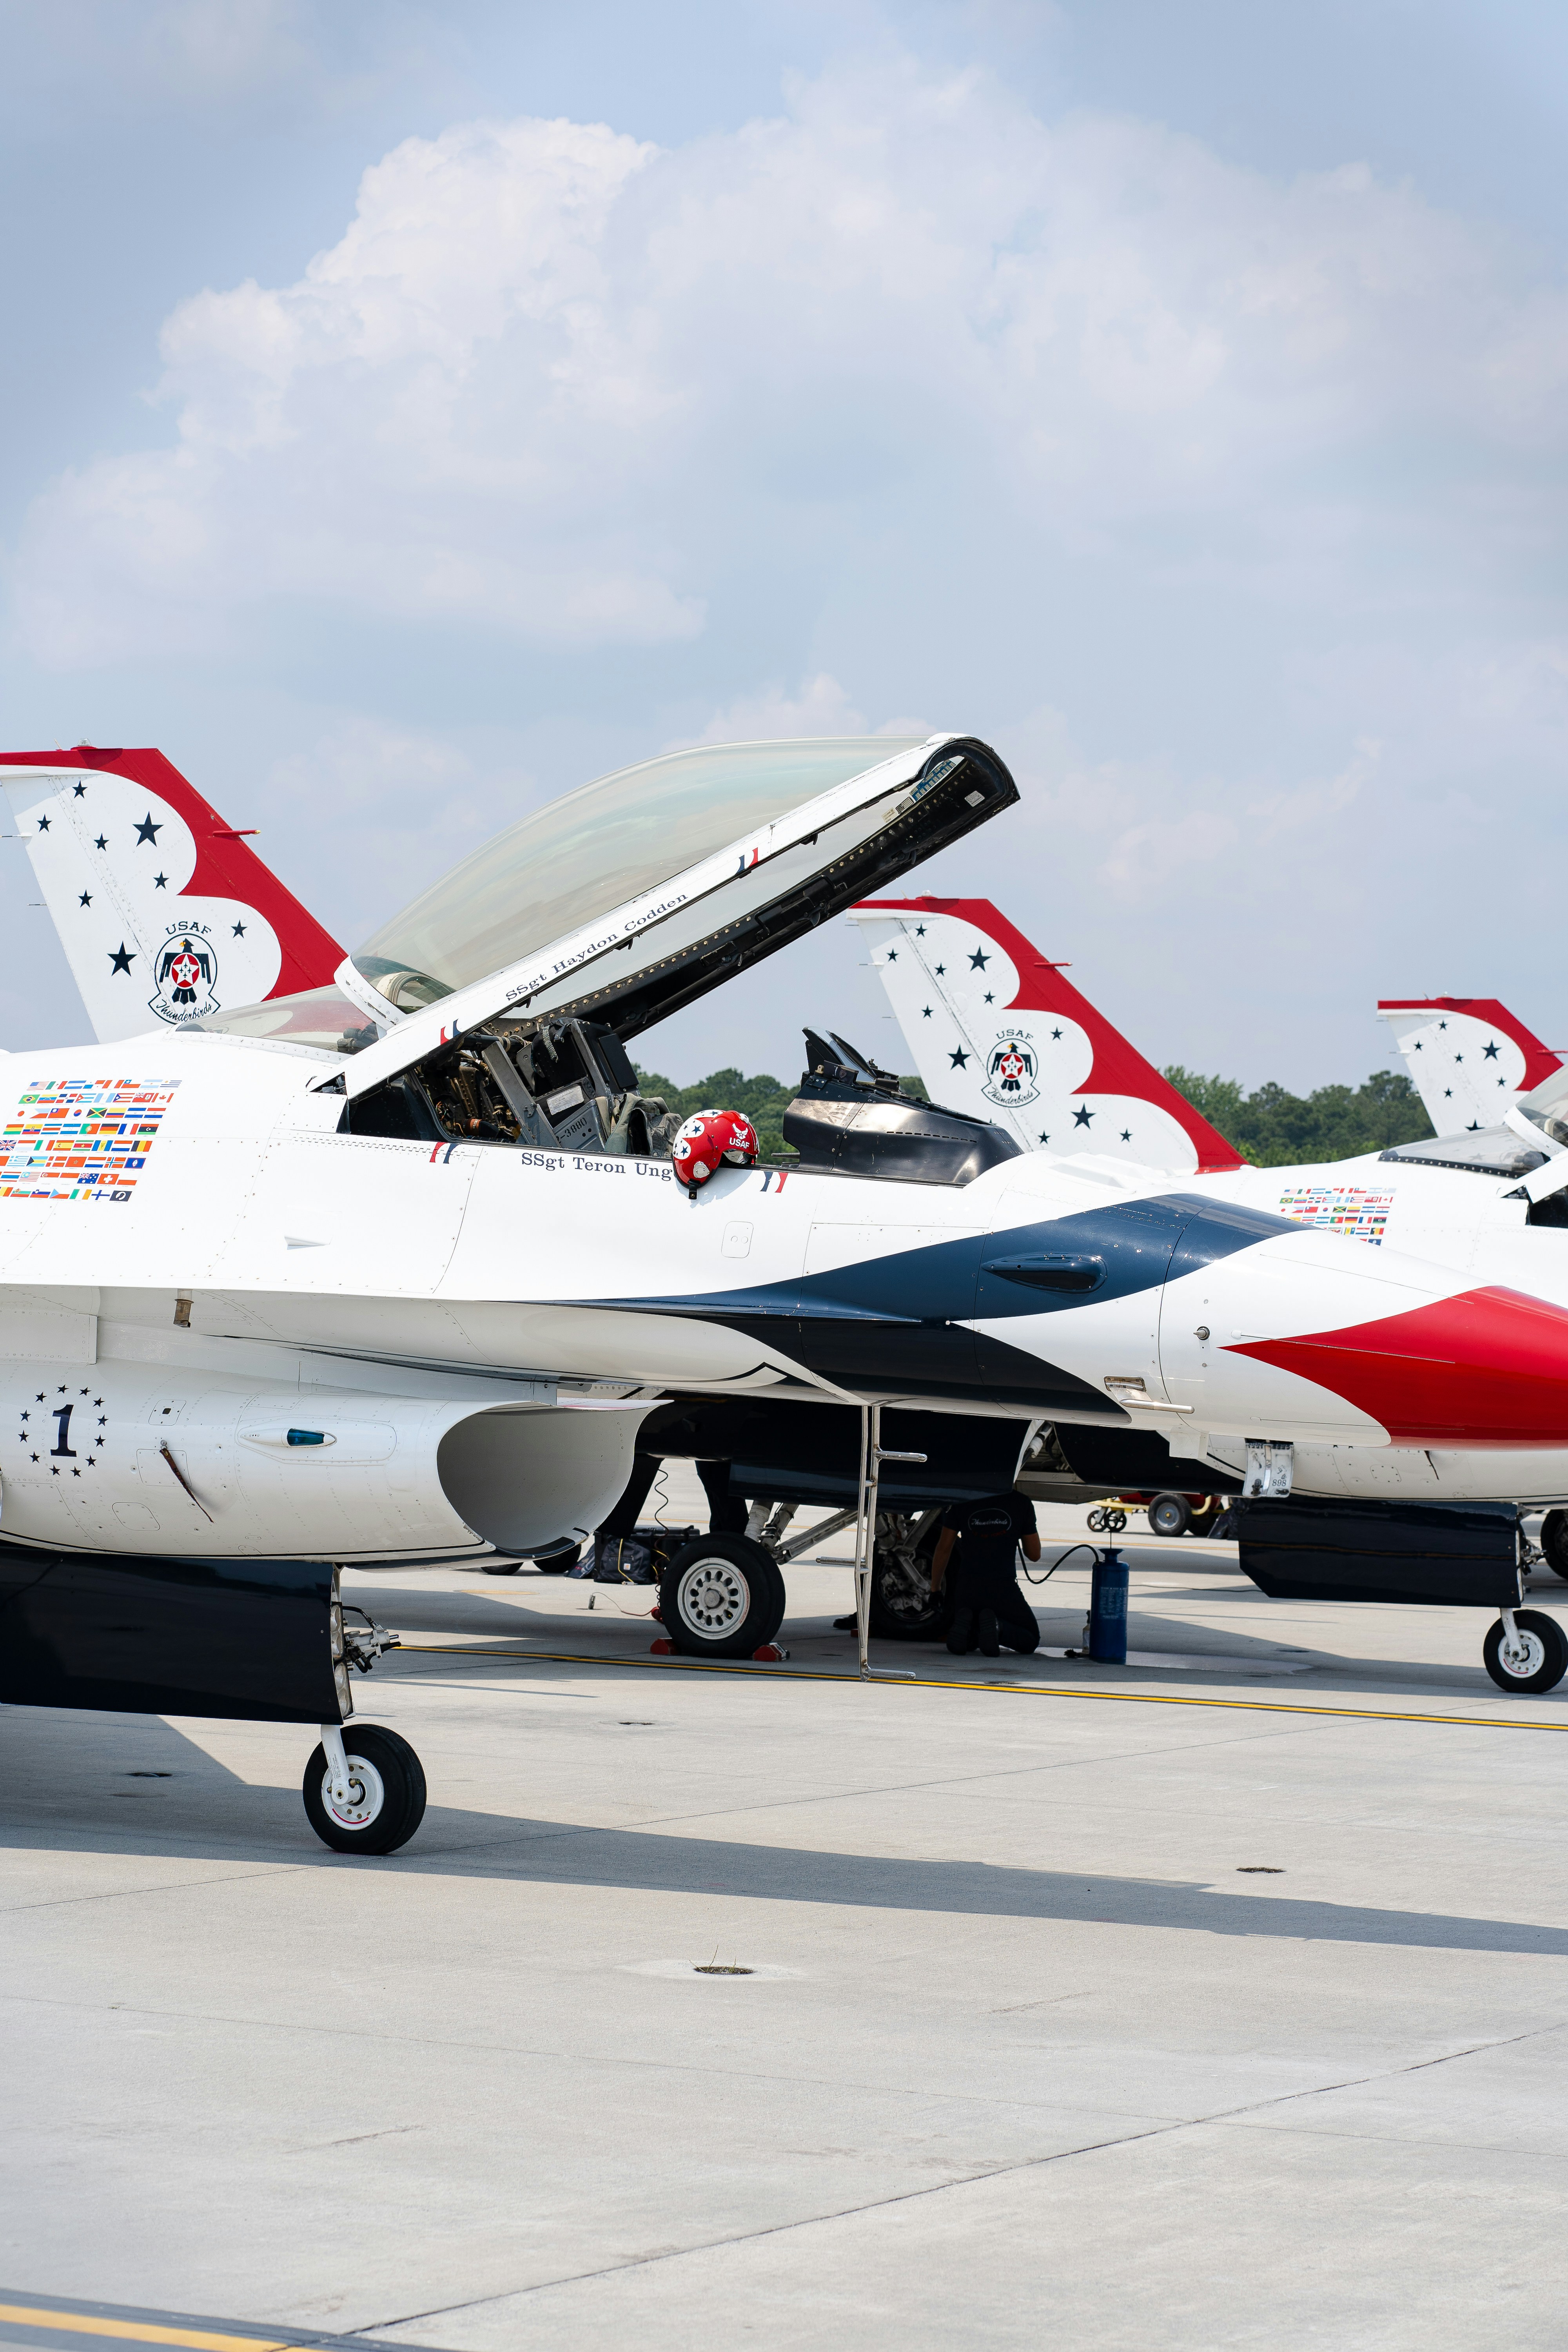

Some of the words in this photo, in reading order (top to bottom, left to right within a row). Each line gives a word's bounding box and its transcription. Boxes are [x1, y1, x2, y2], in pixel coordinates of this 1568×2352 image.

[165, 921, 212, 935] USAF
[505, 974, 547, 1001] SSgt
[551, 933, 619, 974] Haydon
[624, 893, 688, 931] Codden
[156, 999, 212, 1022] Thunderbirds
[996, 1029, 1033, 1040] USAF
[987, 1086, 1033, 1105] Thunderbirds
[729, 1137, 750, 1149] USAF
[522, 1152, 564, 1171] SSgt
[573, 1157, 626, 1174] Teron
[634, 1162, 676, 1181] Ung
[50, 1404, 77, 1457] 1
